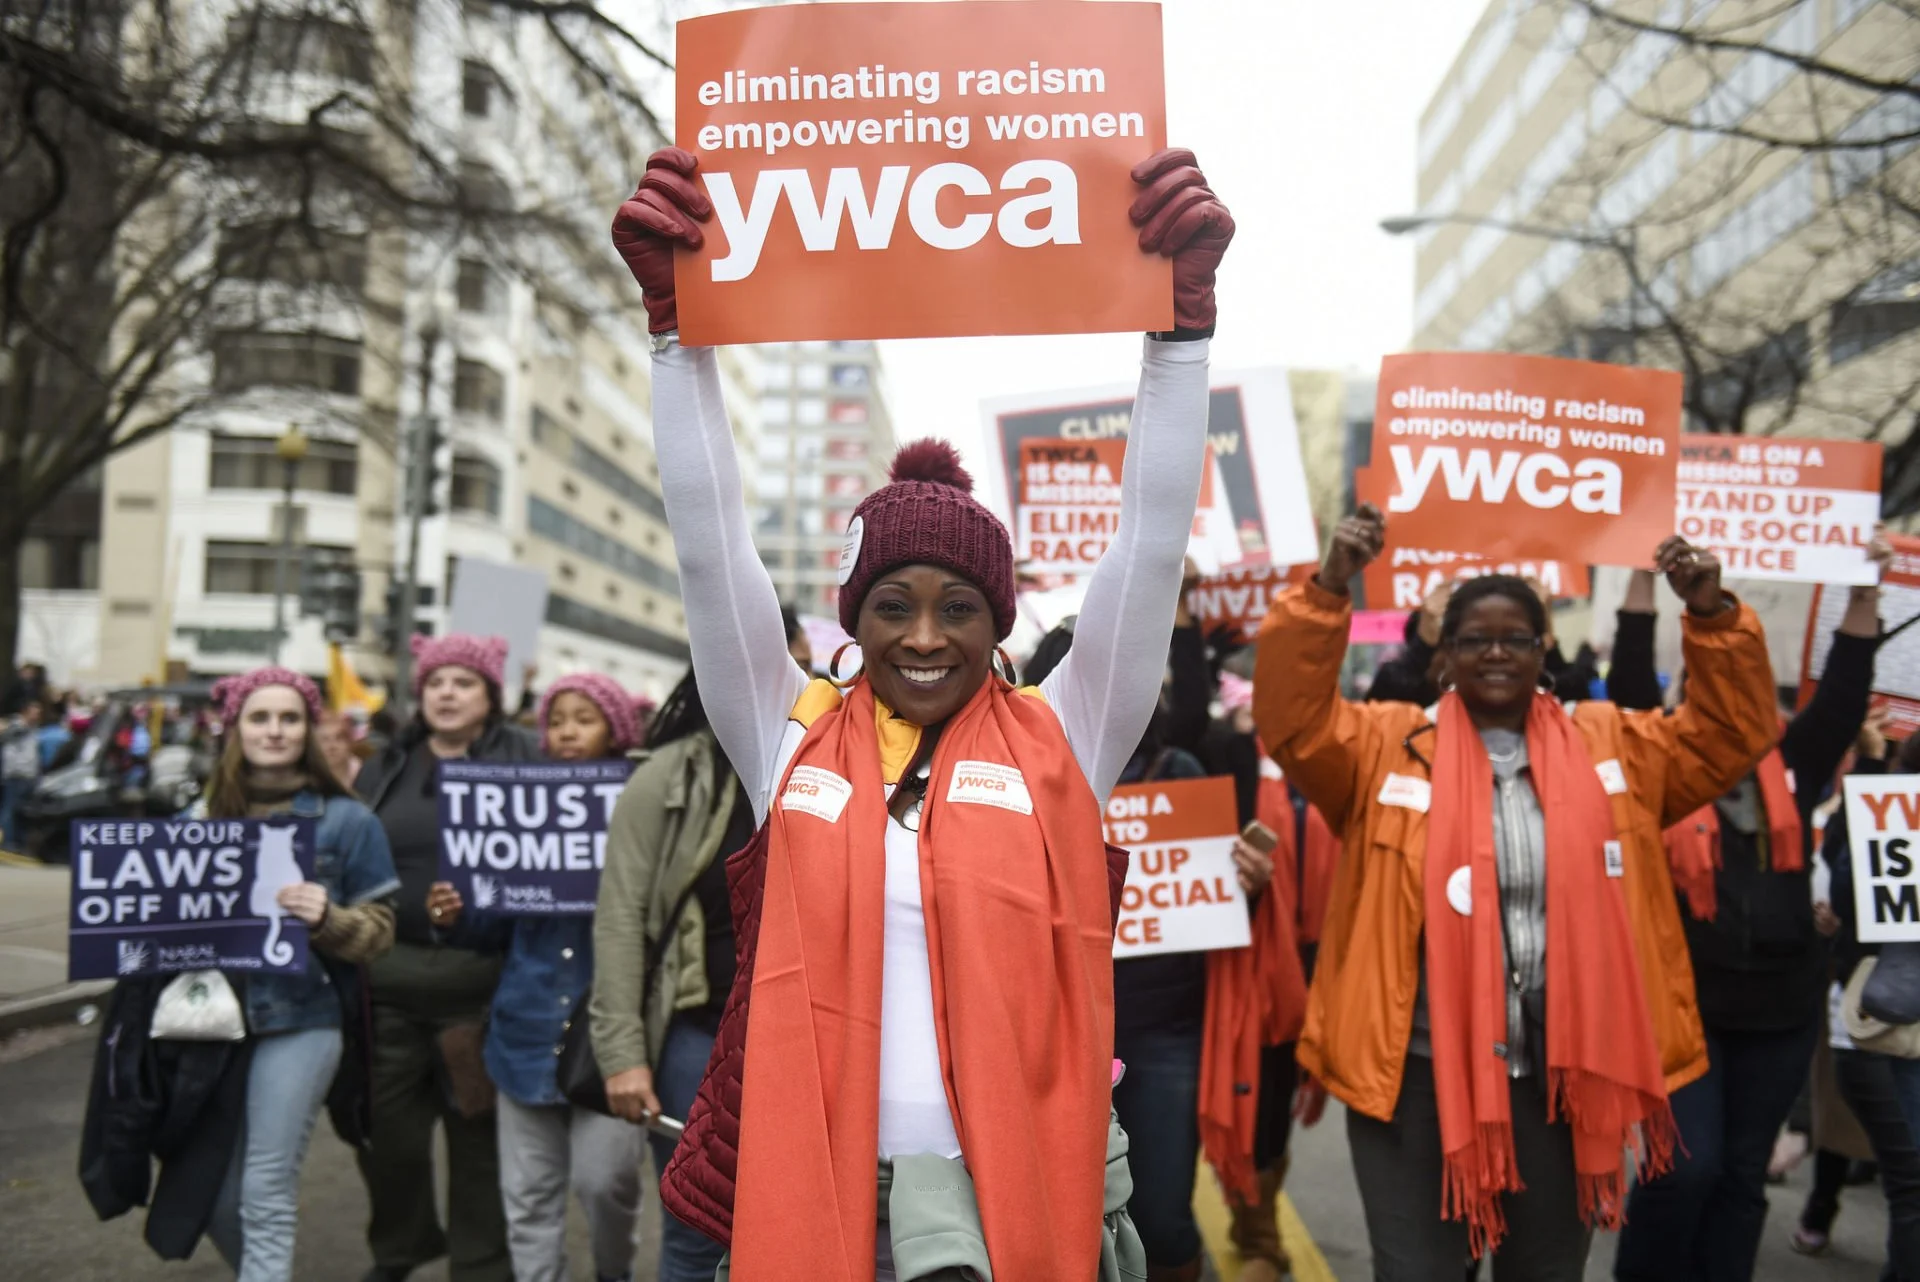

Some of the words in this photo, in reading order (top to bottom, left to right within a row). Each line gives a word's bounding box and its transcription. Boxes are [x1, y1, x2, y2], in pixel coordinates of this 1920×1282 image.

[698, 64, 941, 105] eliminating
[957, 61, 1106, 96] racism
[698, 110, 971, 154] empowering
[984, 111, 1145, 141] women
[702, 159, 1081, 282] ywca
[1391, 386, 1546, 419] eliminating
[1554, 398, 1645, 426] racism
[1059, 412, 1131, 441] CLIM
[1389, 415, 1561, 449] empowering
[1569, 425, 1665, 456] women
[1680, 446, 1733, 462] WCA
[1737, 444, 1761, 464] IS
[1764, 445, 1802, 466] ON
[1804, 447, 1824, 467] A
[1388, 444, 1623, 515] ywca
[1767, 466, 1799, 486] TO
[1682, 489, 1776, 514] TAND
[1786, 494, 1834, 517] UP
[1680, 516, 1728, 539] OR
[1740, 520, 1868, 548] SOCIAL
[956, 775, 1007, 792] ywca
[441, 781, 624, 829] TRUST
[1107, 794, 1148, 818] ON
[1152, 792, 1174, 815] A
[79, 822, 155, 846] KEEP
[164, 821, 245, 845] YOUR
[1111, 819, 1148, 843] TO
[78, 846, 243, 890] LAWS
[1139, 847, 1190, 877] UP
[1867, 838, 1914, 878] IS
[78, 893, 162, 925] OFF
[178, 890, 241, 920] MY
[1119, 877, 1234, 912] OCIAL
